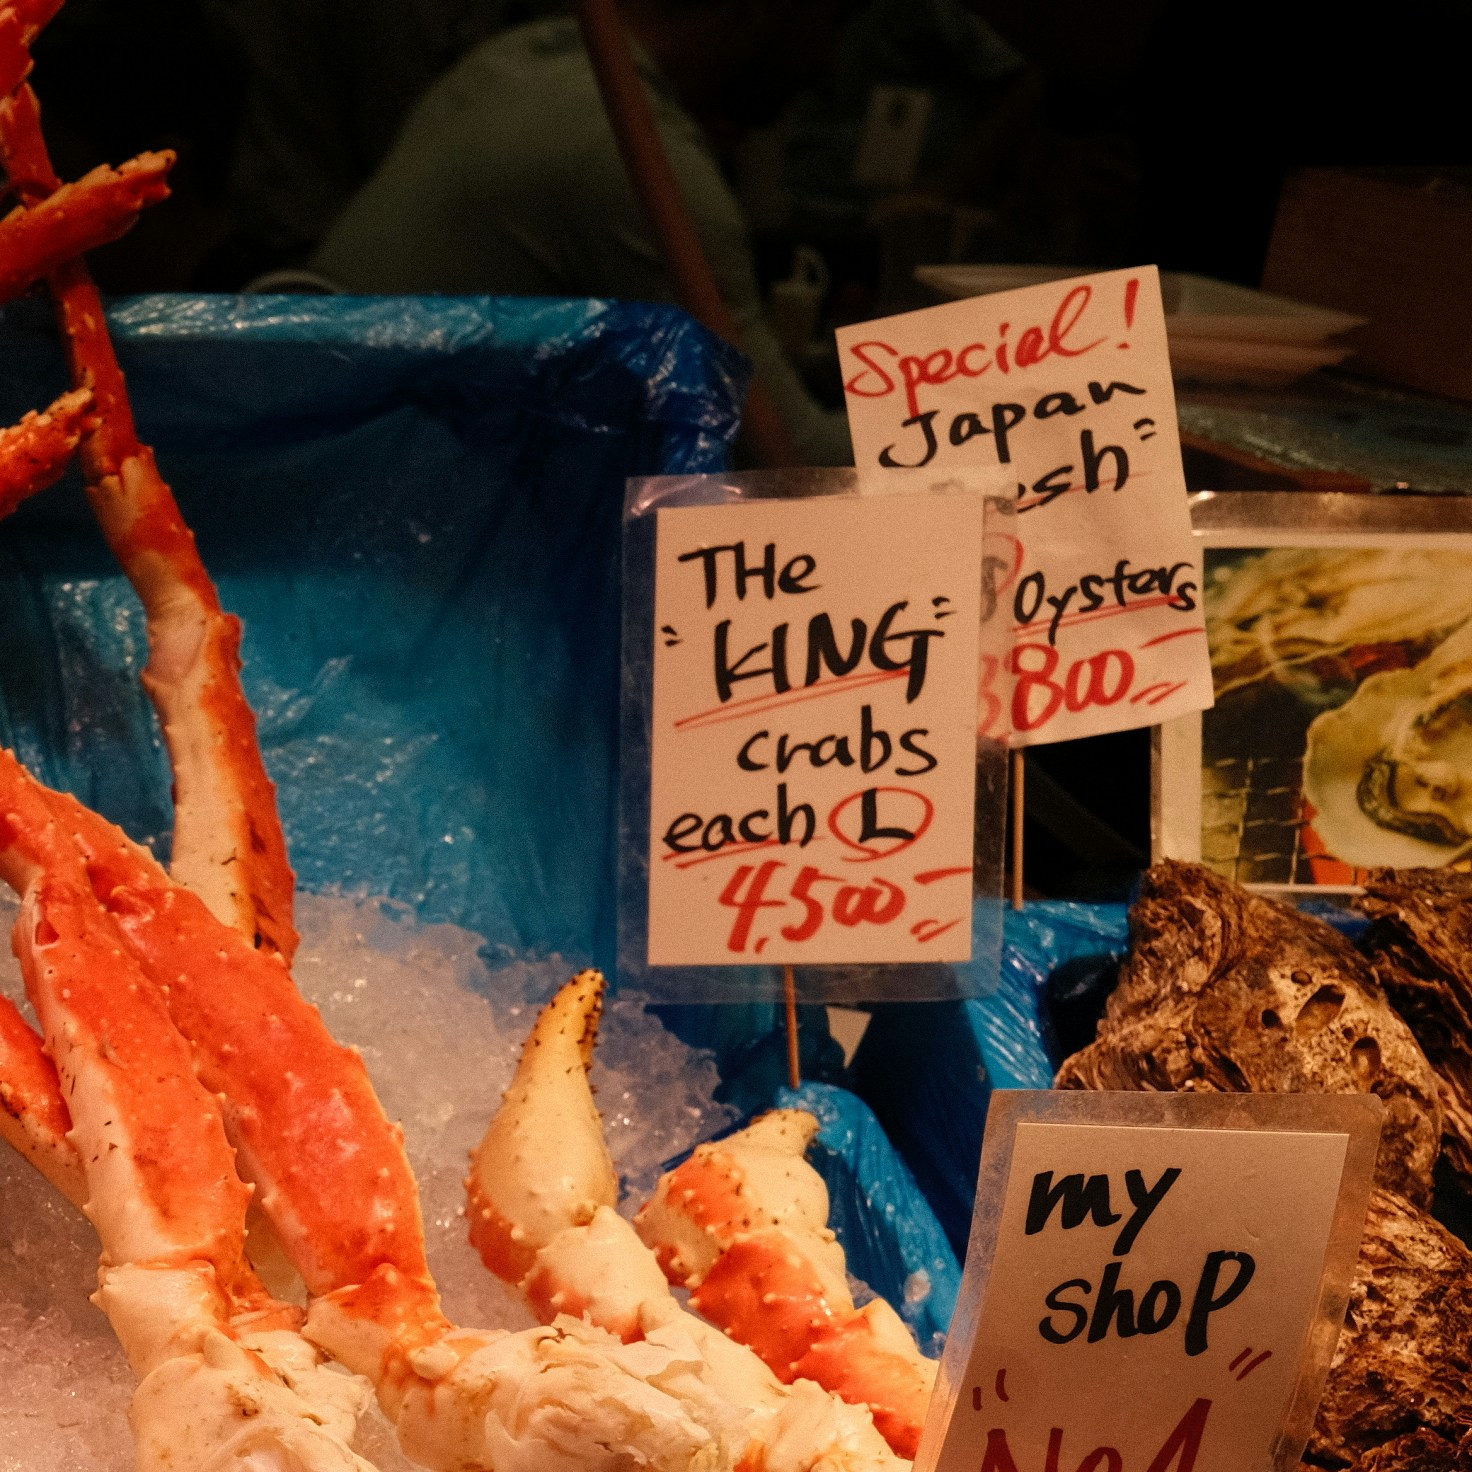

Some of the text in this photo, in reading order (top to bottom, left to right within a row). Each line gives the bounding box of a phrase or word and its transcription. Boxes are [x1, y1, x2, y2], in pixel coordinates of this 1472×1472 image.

[662, 783, 916, 853] each L
[1024, 1166, 1183, 1256] my
